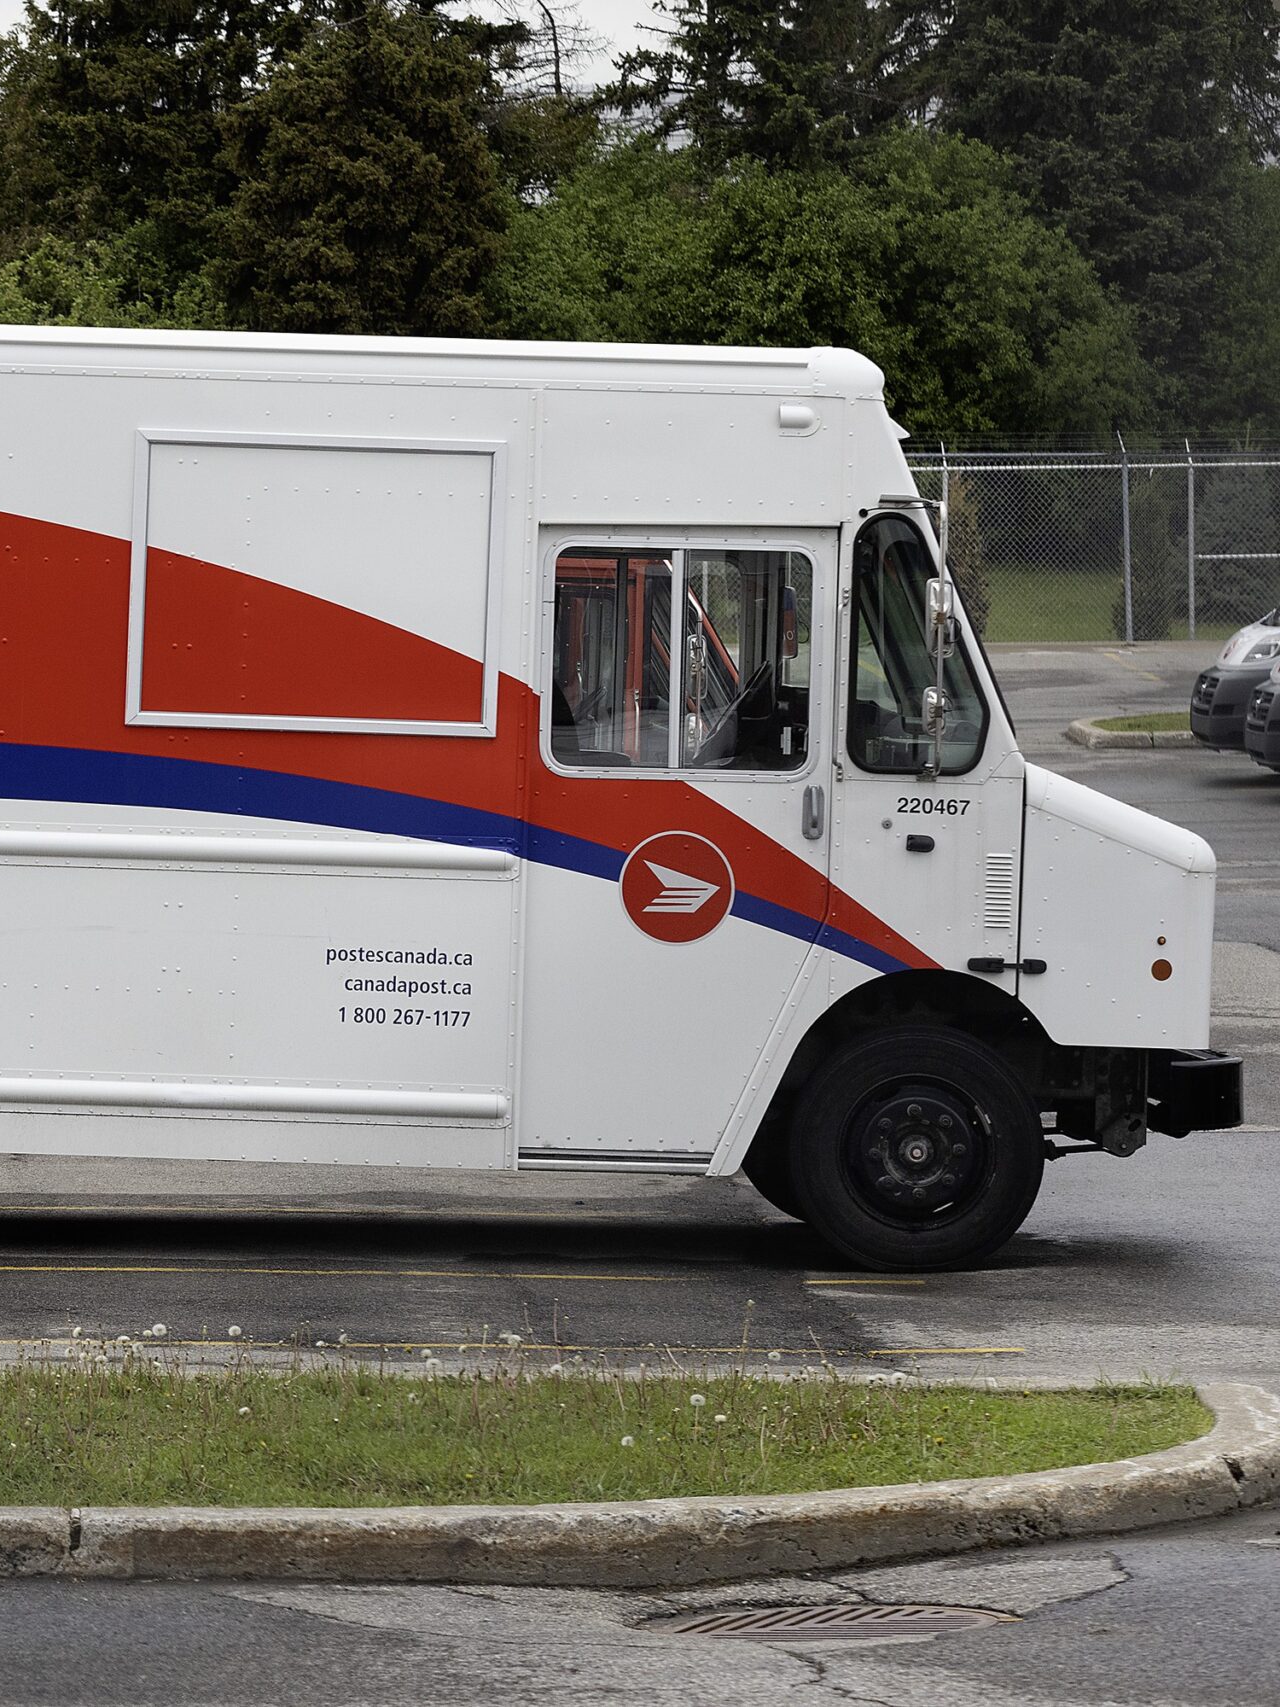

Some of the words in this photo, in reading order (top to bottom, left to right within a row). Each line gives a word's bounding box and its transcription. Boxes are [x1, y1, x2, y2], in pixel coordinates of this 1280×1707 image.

[896, 797, 971, 816] 220467
[326, 947, 473, 966] postescanada.ca
[344, 975, 472, 998] canadapost.ca
[338, 1006, 346, 1023] 1
[353, 1007, 386, 1024] 800
[392, 1008, 471, 1028] 267-1177
